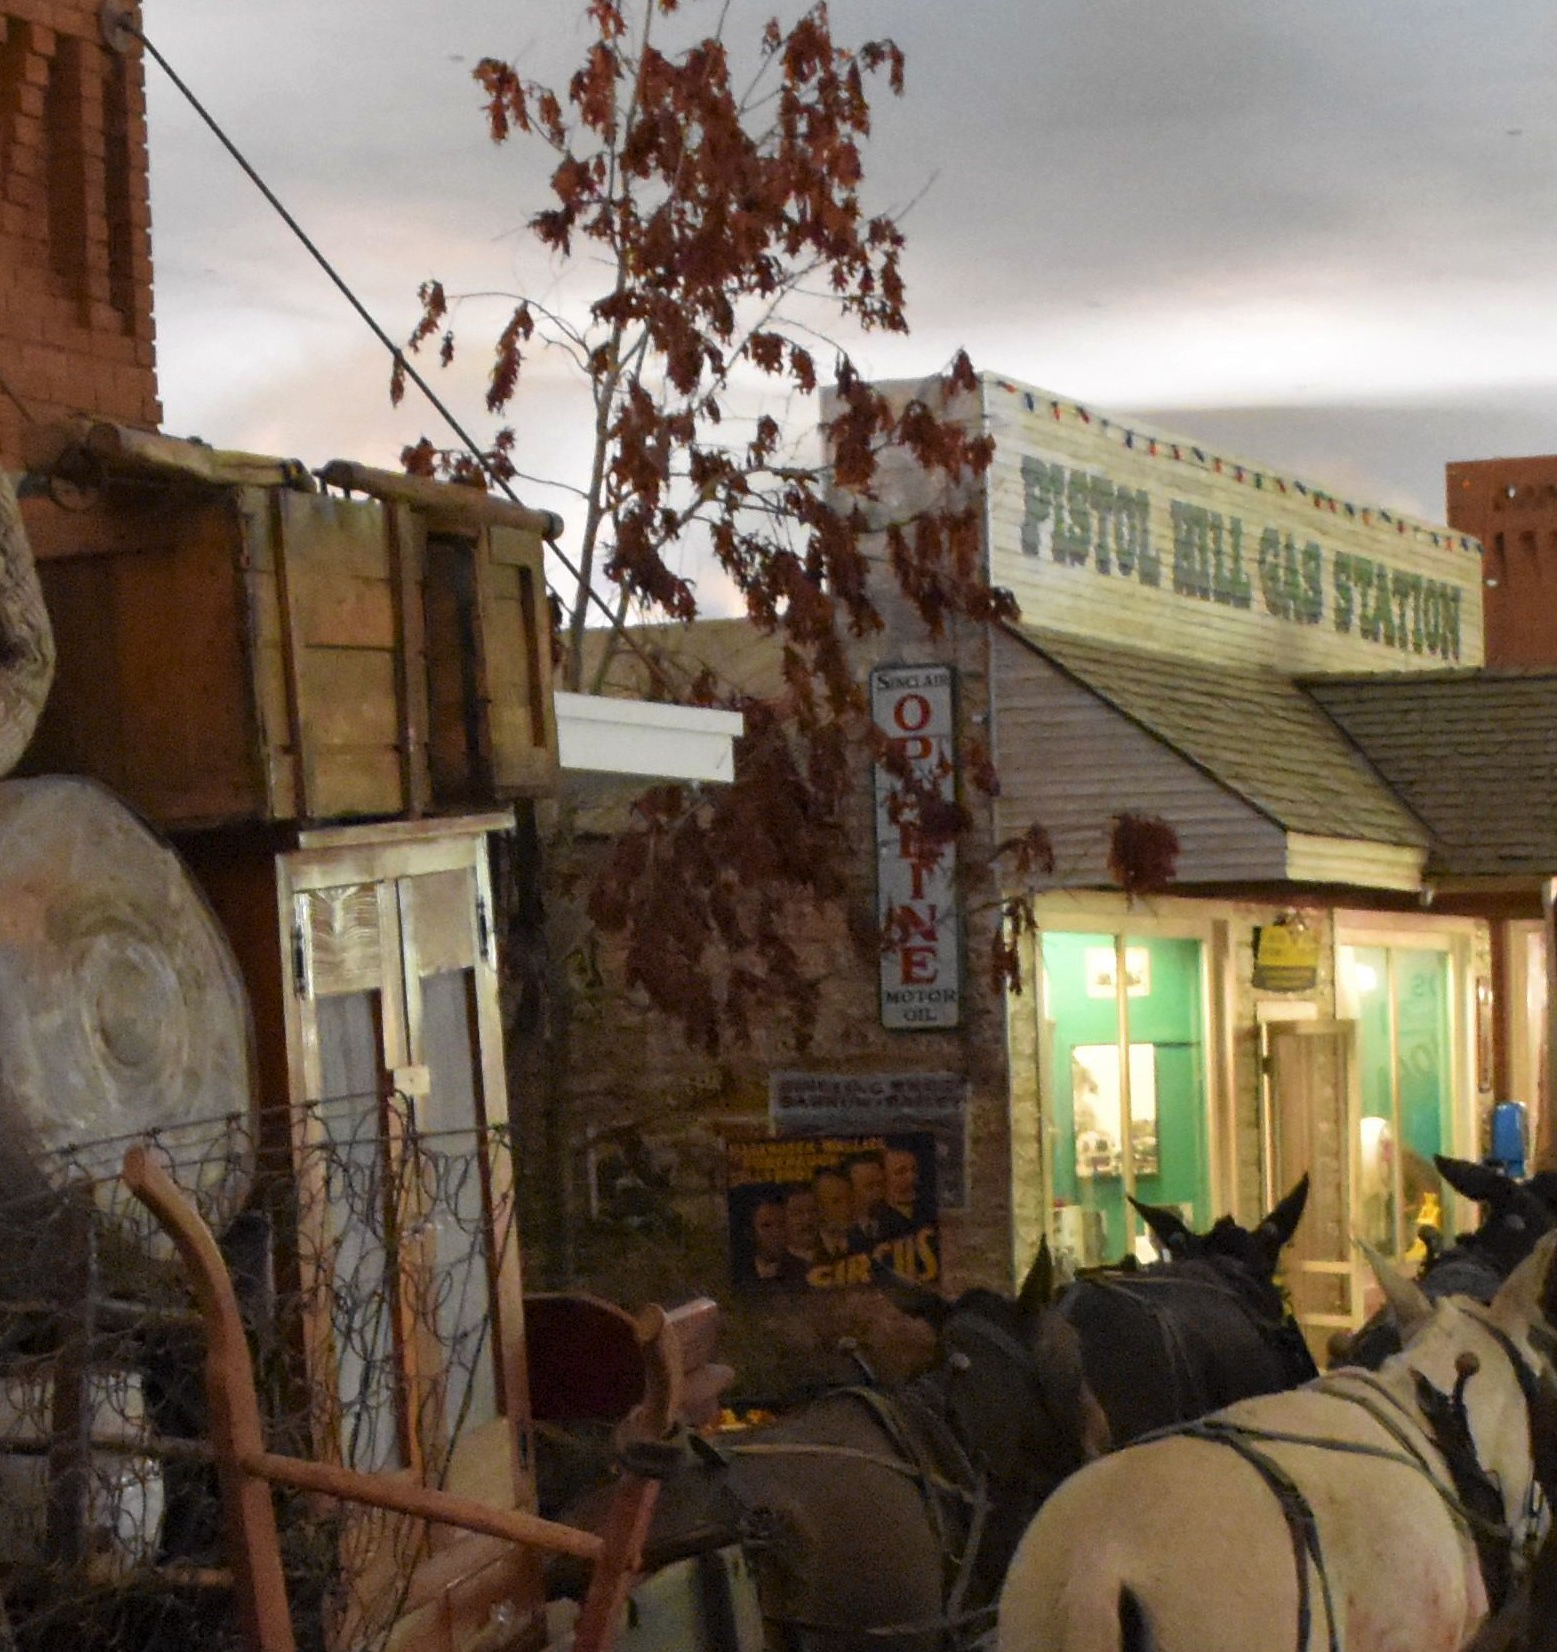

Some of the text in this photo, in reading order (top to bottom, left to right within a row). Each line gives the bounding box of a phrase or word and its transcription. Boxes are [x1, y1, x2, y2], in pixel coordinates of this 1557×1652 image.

[1021, 454, 1461, 664] PISTOL HILL GAS STATION
[885, 988, 956, 1004] MOTOR
[903, 1007, 938, 1022] OIL
